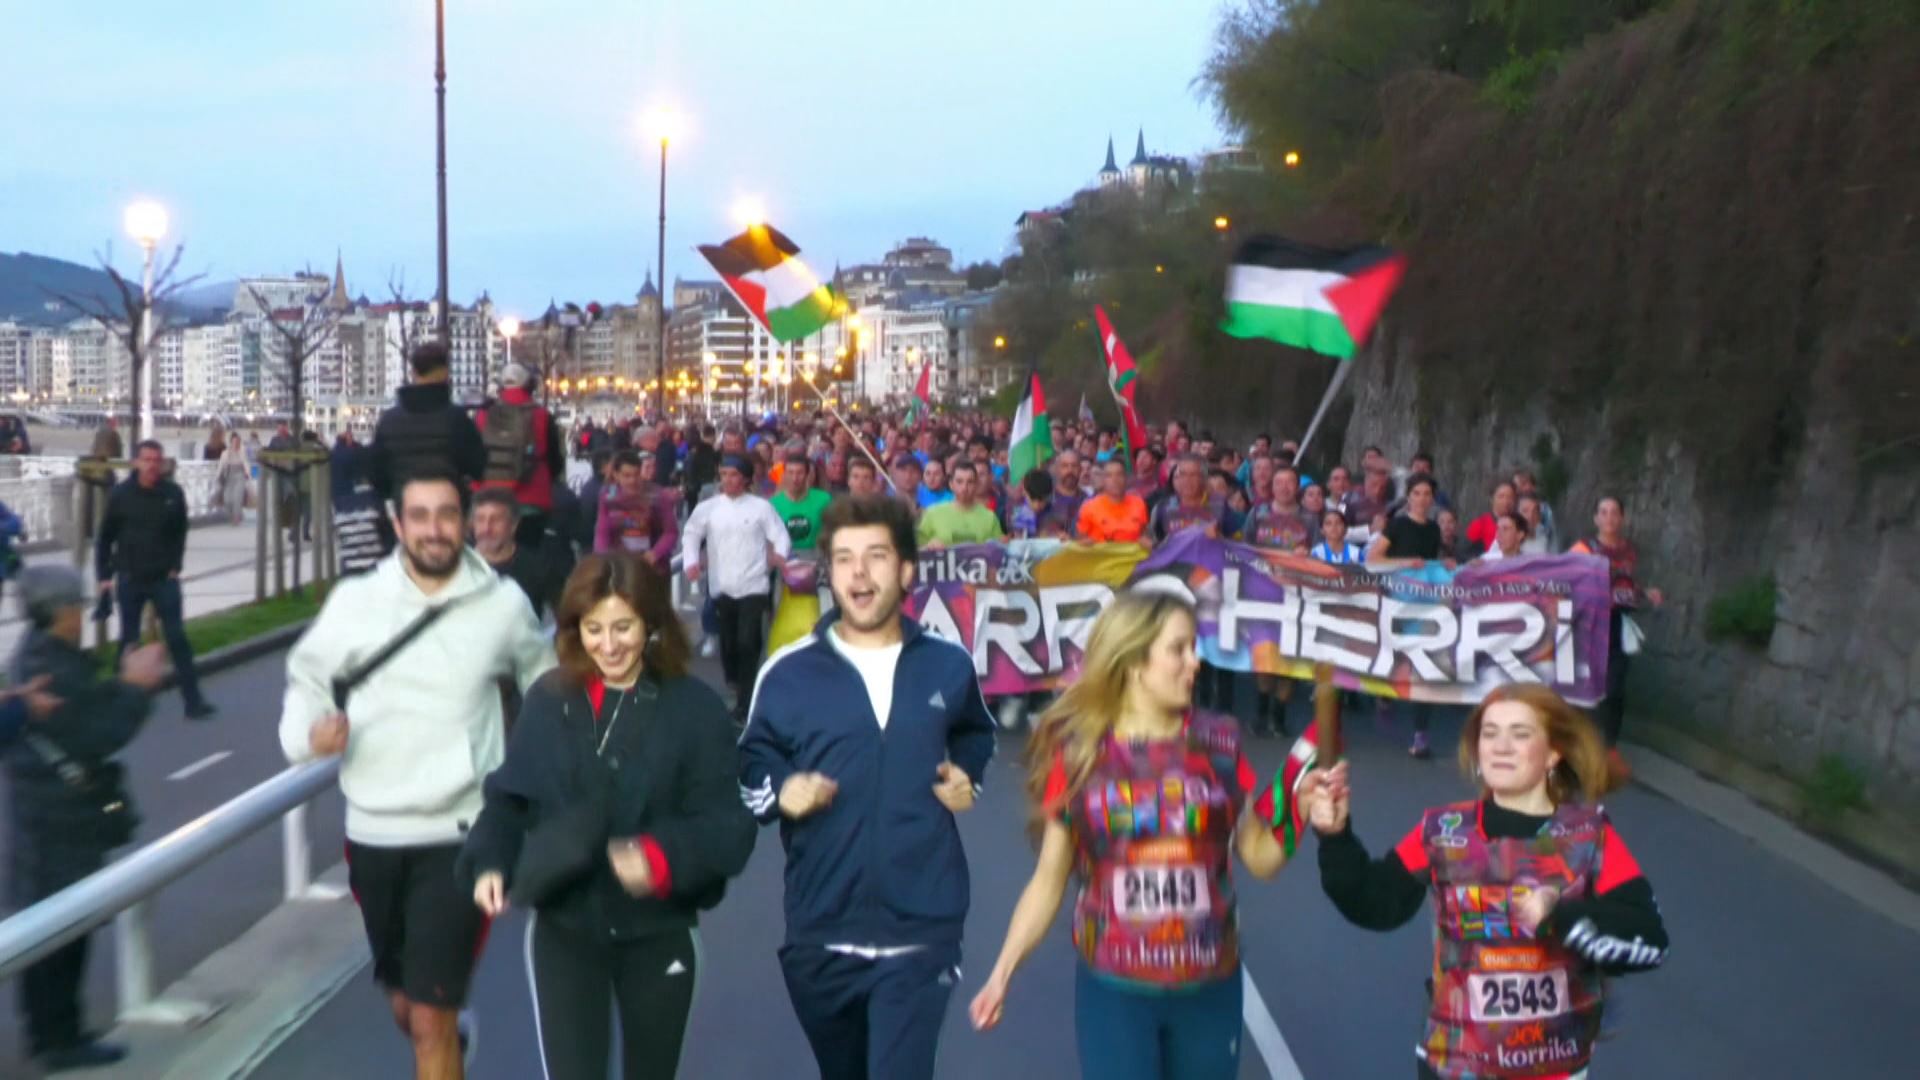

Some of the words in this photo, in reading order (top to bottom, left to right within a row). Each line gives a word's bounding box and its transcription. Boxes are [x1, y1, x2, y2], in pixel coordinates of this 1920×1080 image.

[918, 549, 988, 583] rika
[1482, 975, 1558, 1016] 2543
[1498, 1037, 1579, 1068] korrika
